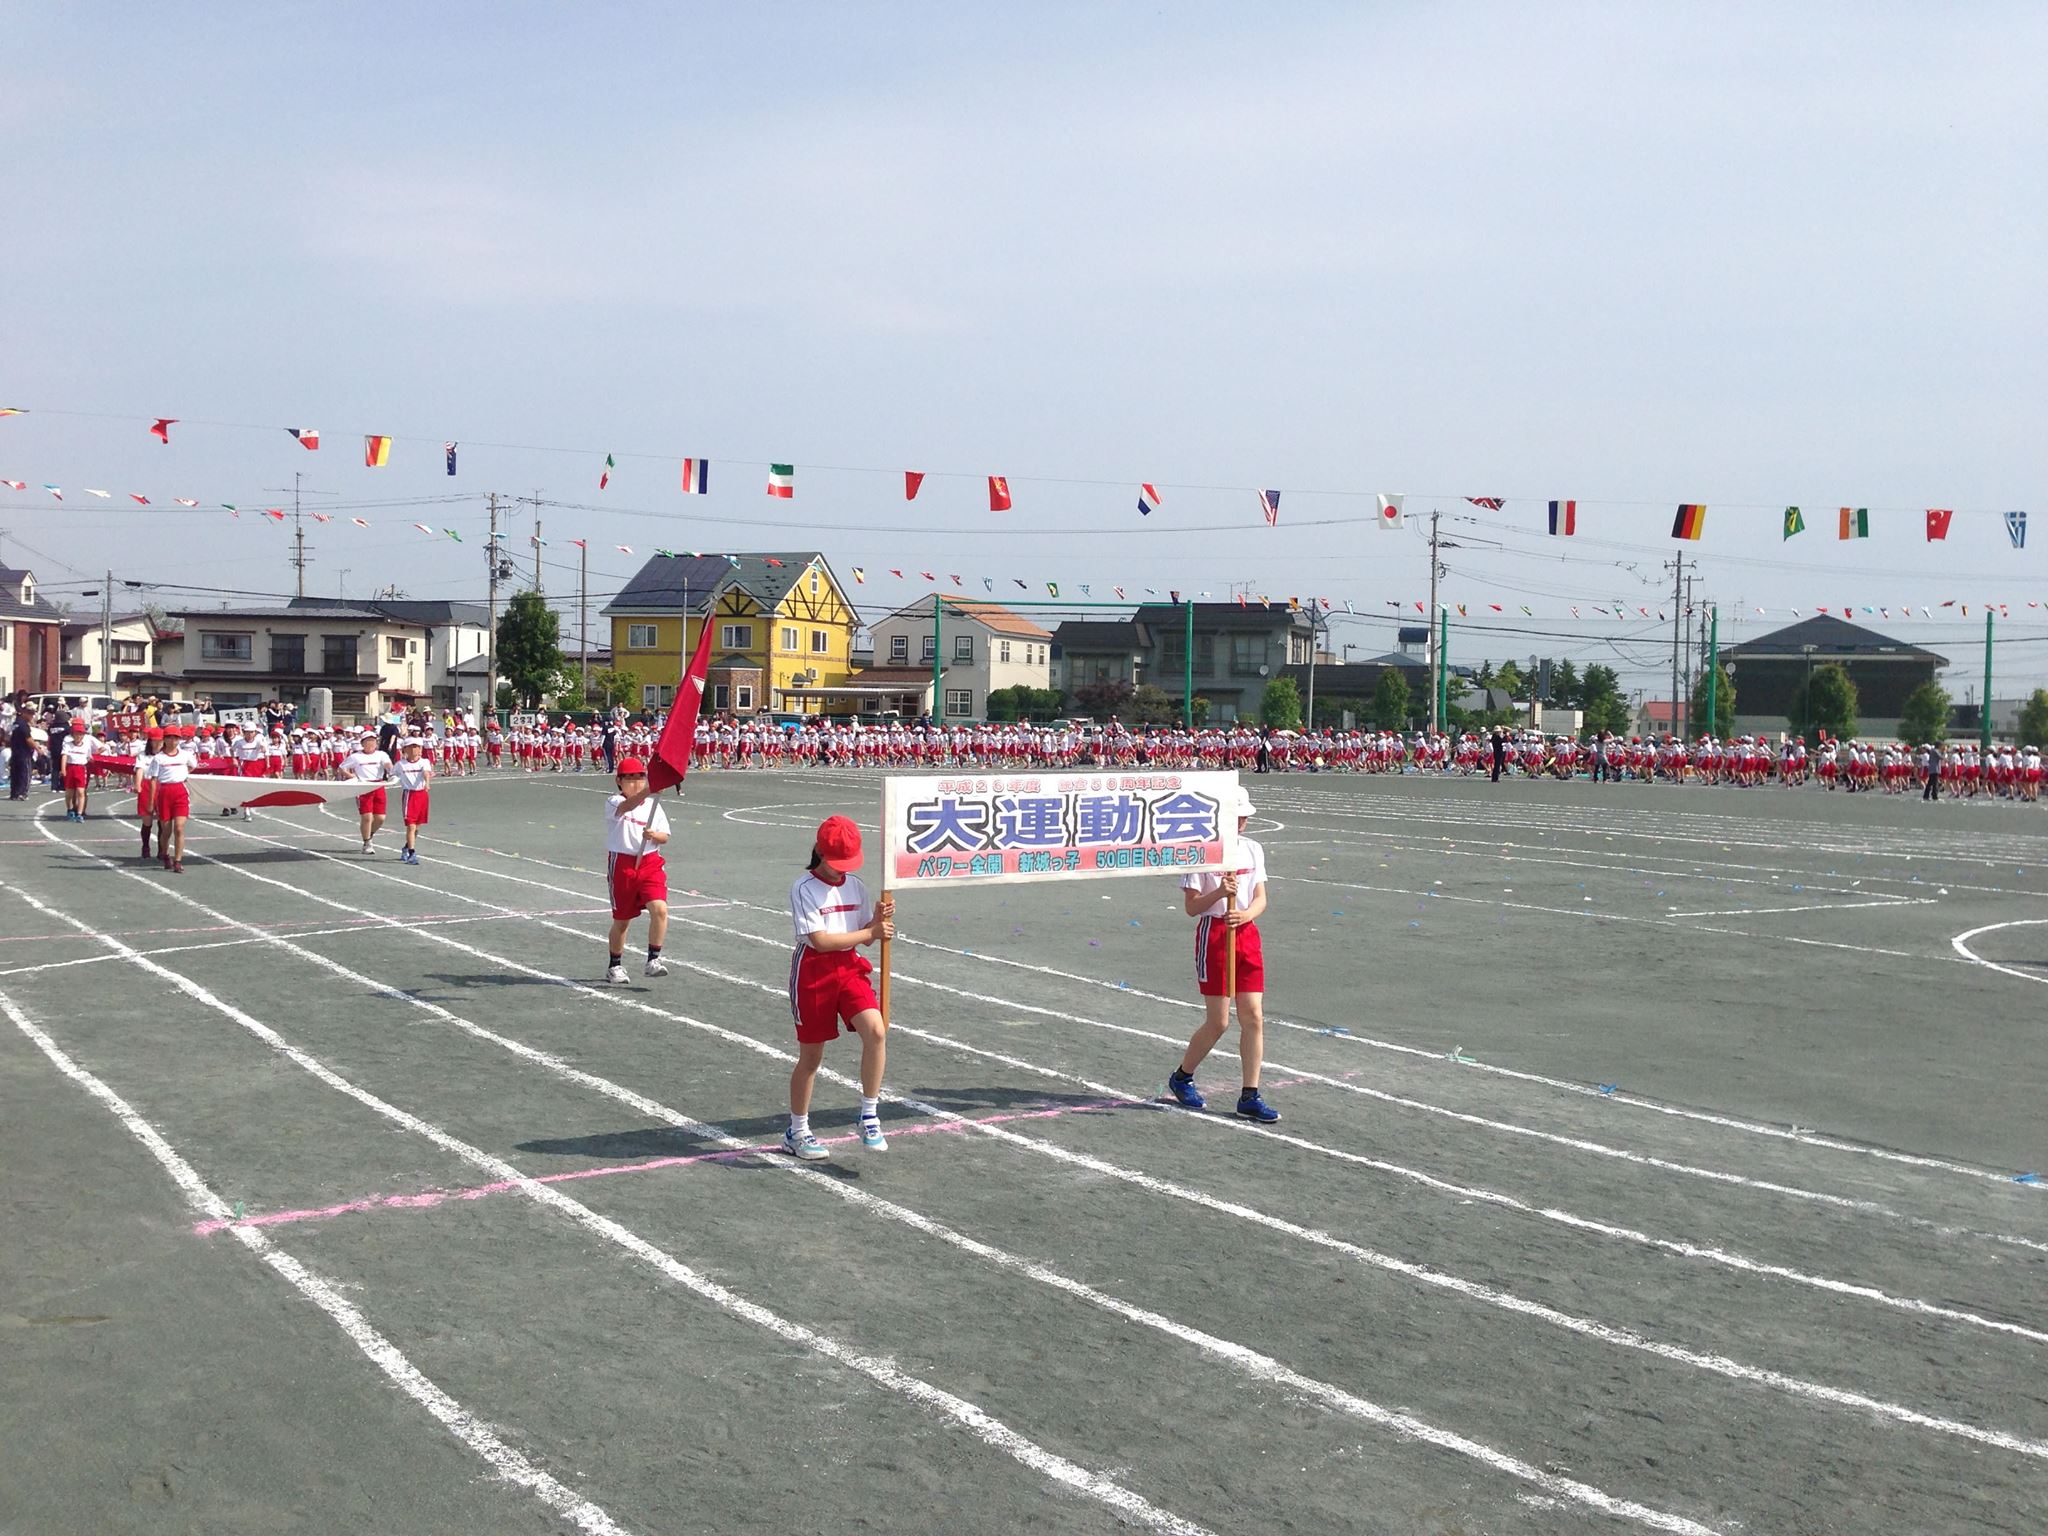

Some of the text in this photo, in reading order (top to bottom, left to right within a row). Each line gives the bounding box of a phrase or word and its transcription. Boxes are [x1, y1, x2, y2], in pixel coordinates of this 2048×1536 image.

[909, 792, 1217, 852] 大運動会
[918, 853, 1004, 877] パワー全開
[1018, 850, 1081, 873] 新城っ子
